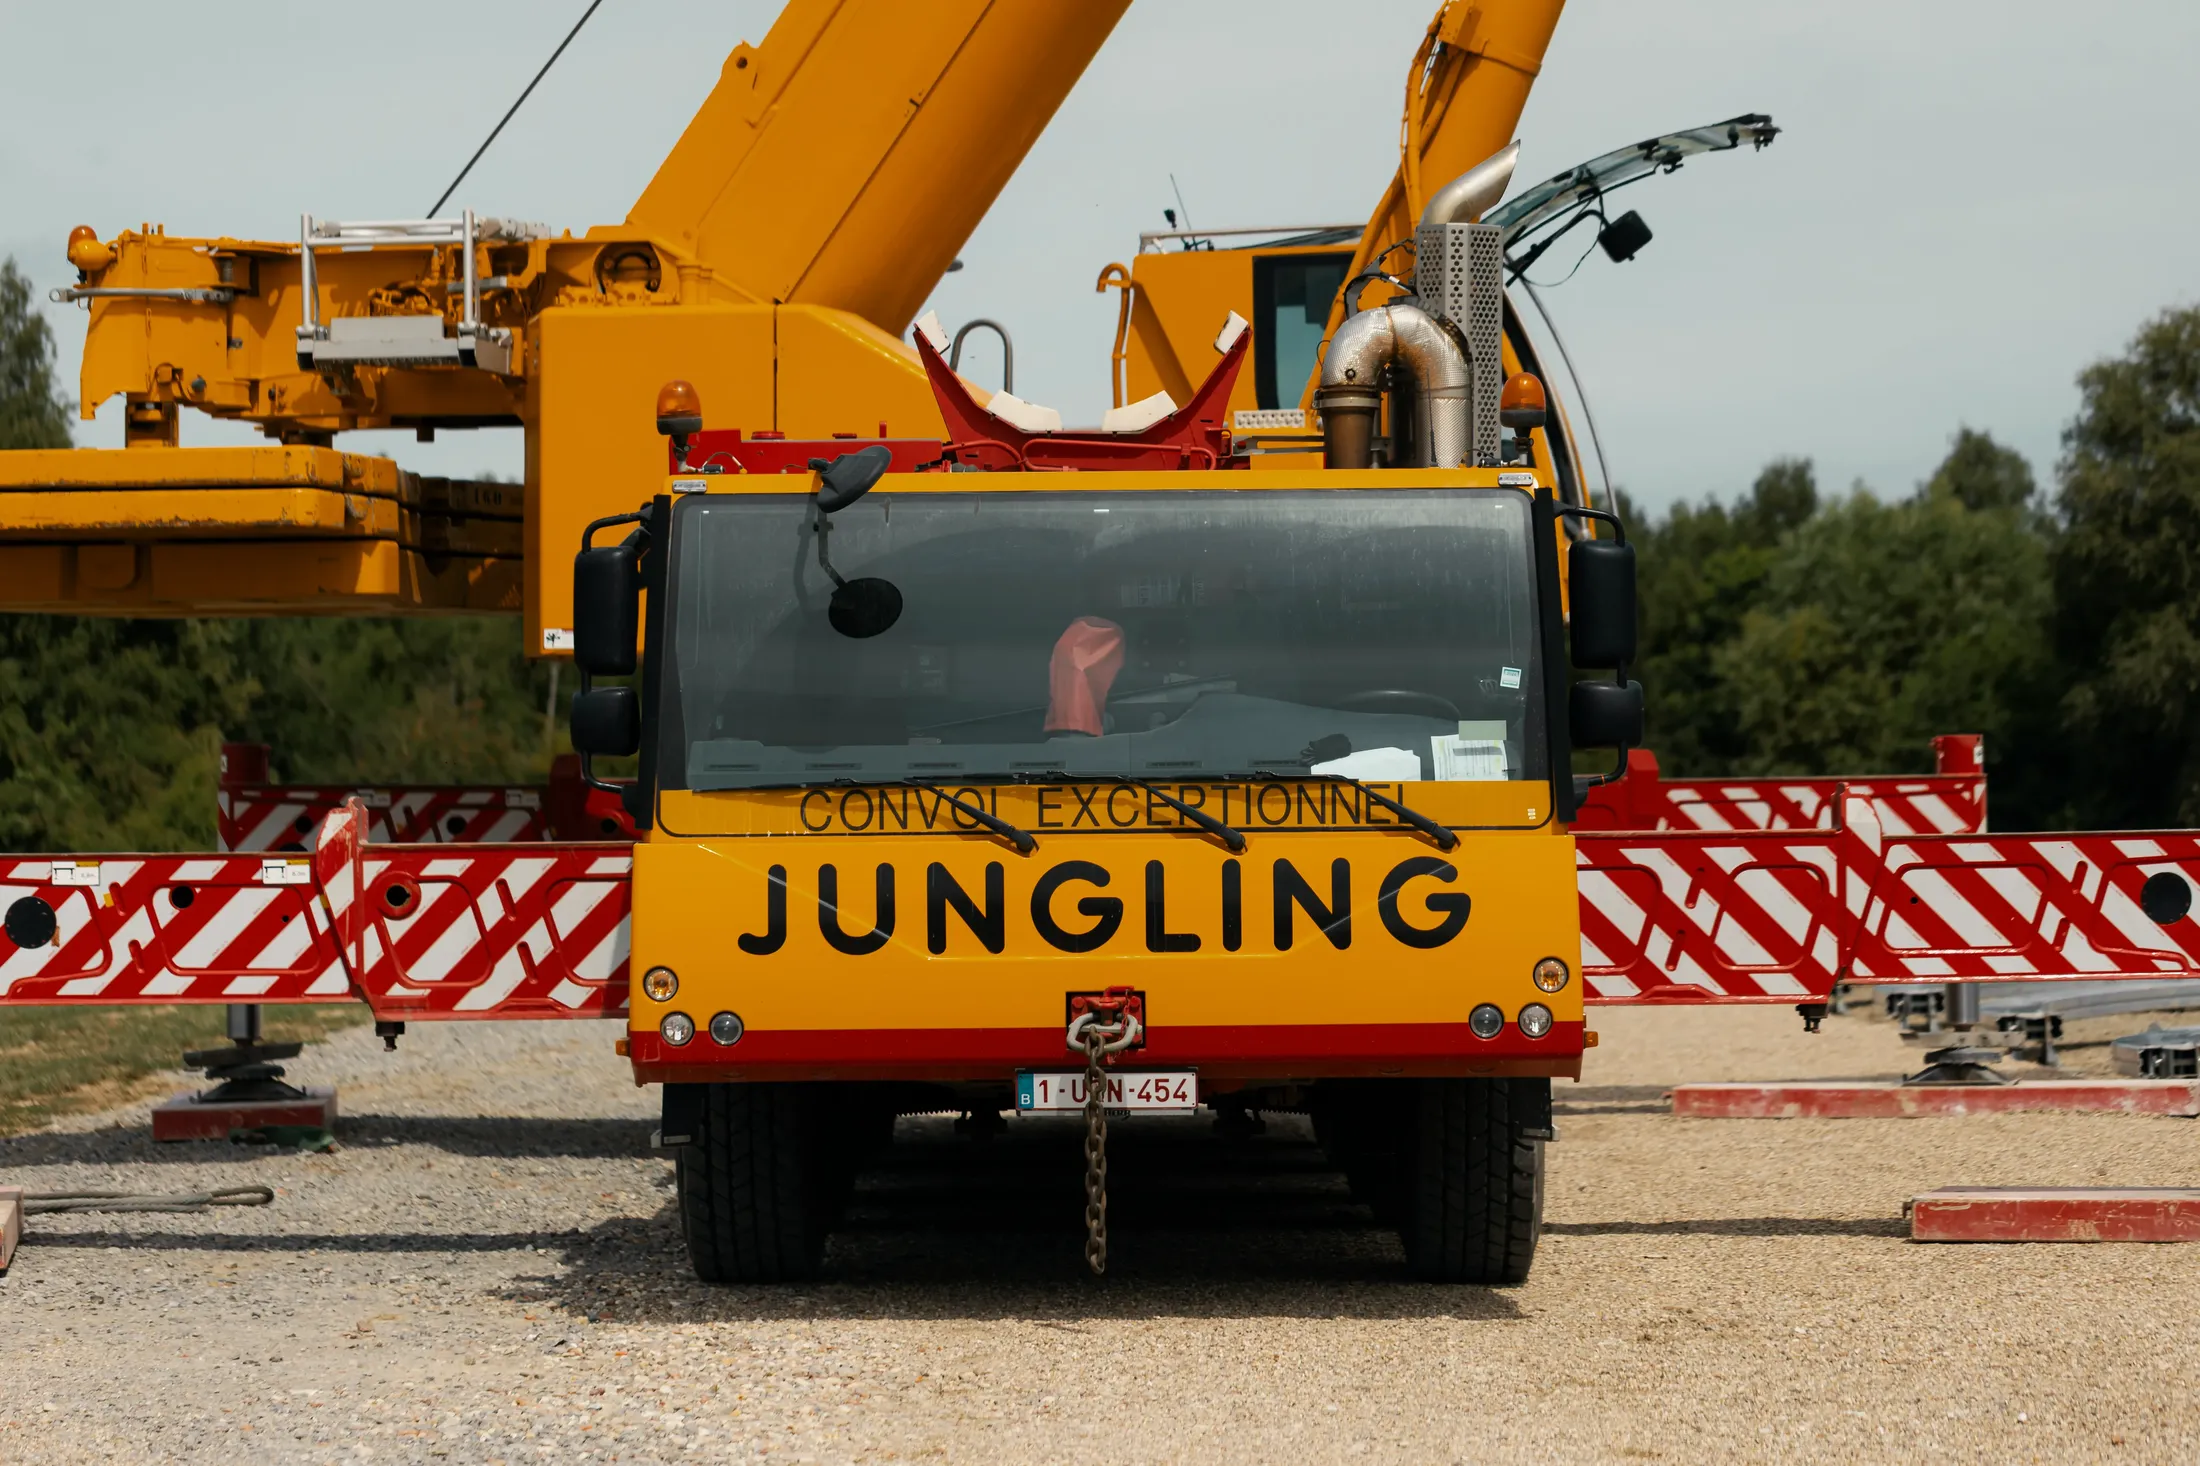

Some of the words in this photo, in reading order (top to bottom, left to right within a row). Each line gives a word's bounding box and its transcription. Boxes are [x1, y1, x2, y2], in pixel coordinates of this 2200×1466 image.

[1037, 783, 1419, 828] EXCEPTIONNEL
[737, 856, 1472, 956] JUNGLING
[1020, 1093, 1031, 1105] B
[1038, 1078, 1188, 1103] 1-UN-454
